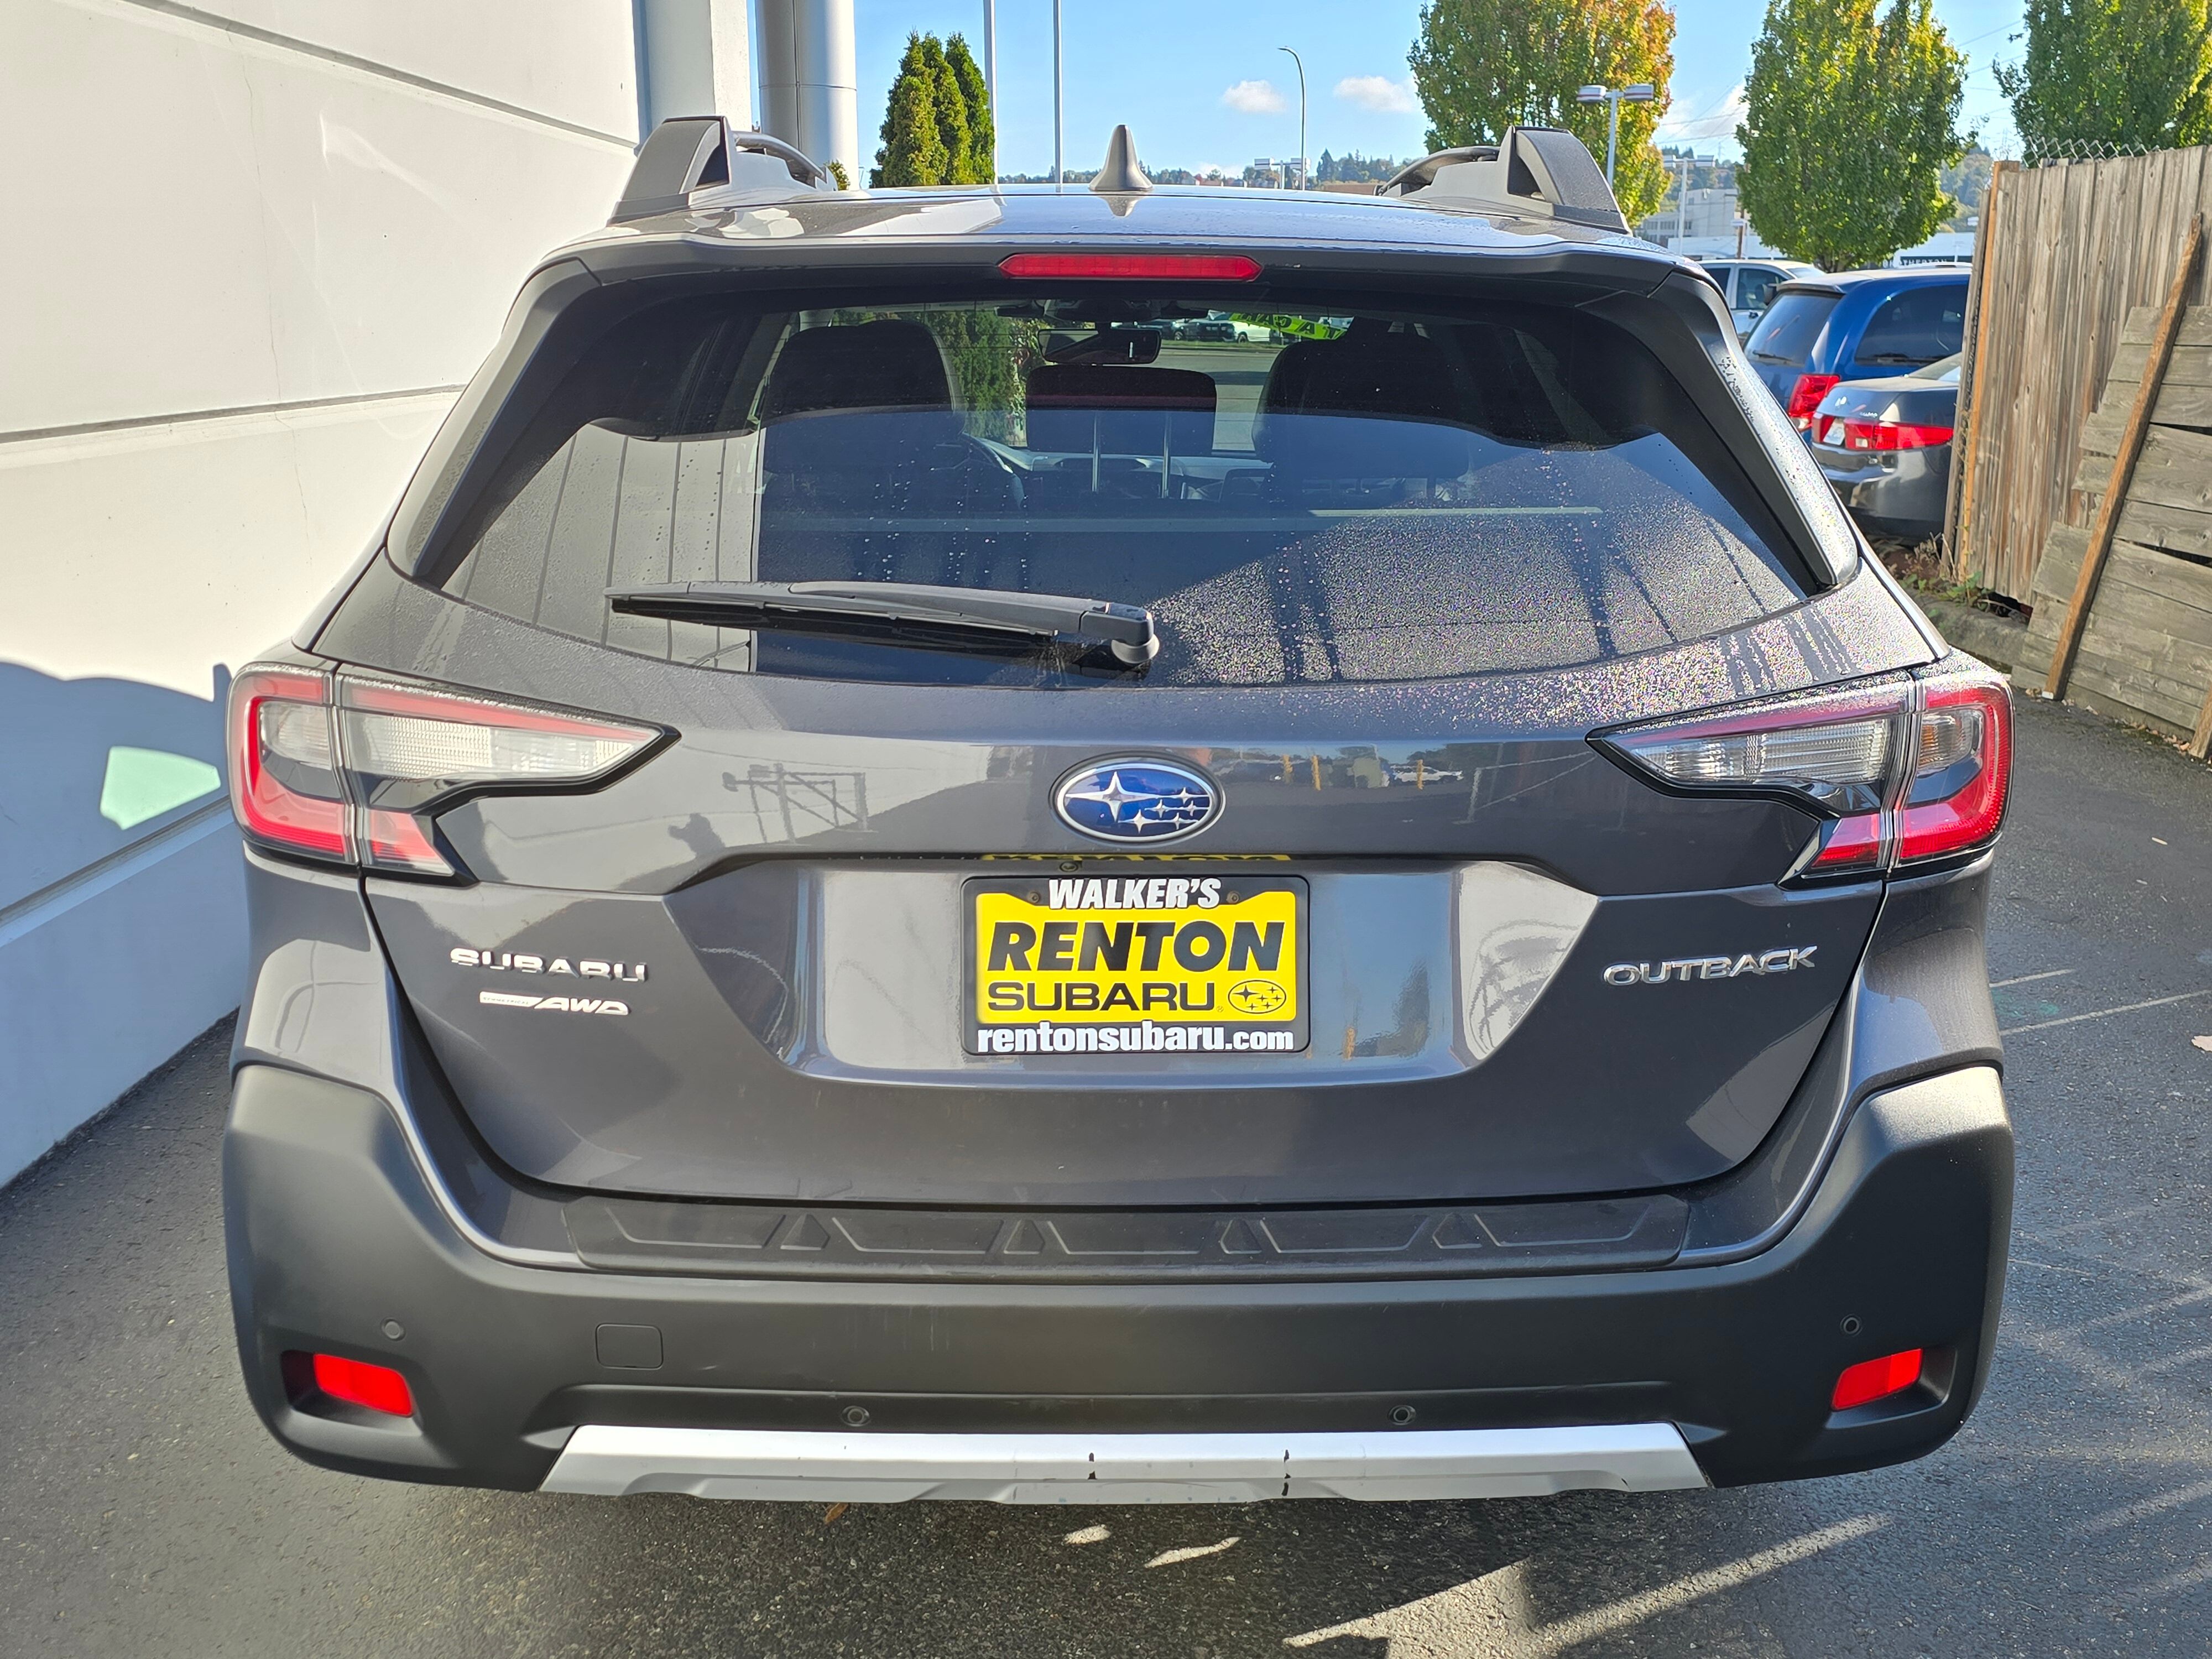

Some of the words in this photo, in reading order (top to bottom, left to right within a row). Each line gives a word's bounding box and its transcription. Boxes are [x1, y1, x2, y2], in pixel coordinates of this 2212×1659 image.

[1048, 878, 1222, 910] WALKER'S
[987, 921, 1285, 972] RENTON
[450, 947, 648, 982] SUBARU
[1603, 946, 1818, 986] OUTBACK
[534, 997, 630, 1016] AWD
[988, 982, 1215, 1011] SUBARU
[977, 1020, 1295, 1053] rentonsubaru.com
